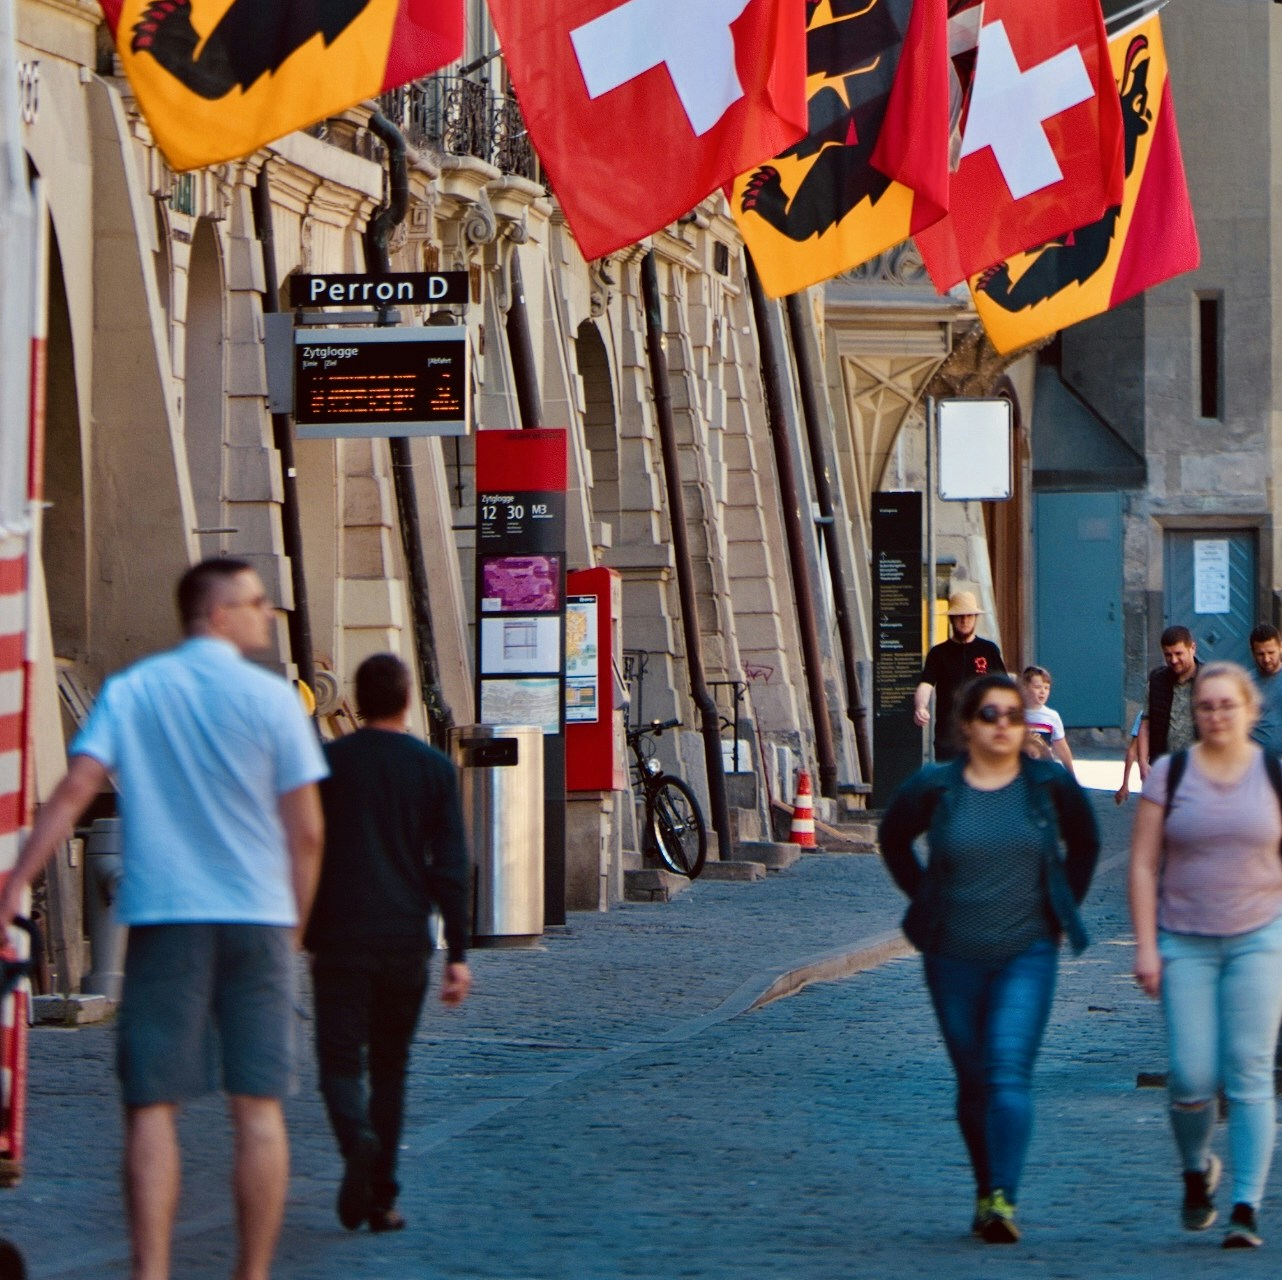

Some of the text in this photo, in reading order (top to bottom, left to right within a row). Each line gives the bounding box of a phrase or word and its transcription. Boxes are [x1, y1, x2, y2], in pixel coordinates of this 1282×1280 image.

[310, 276, 449, 301] Perron D
[303, 346, 359, 359] Zytglogge
[481, 494, 515, 505] Zytglogge
[482, 504, 548, 520] 12 30 M3
